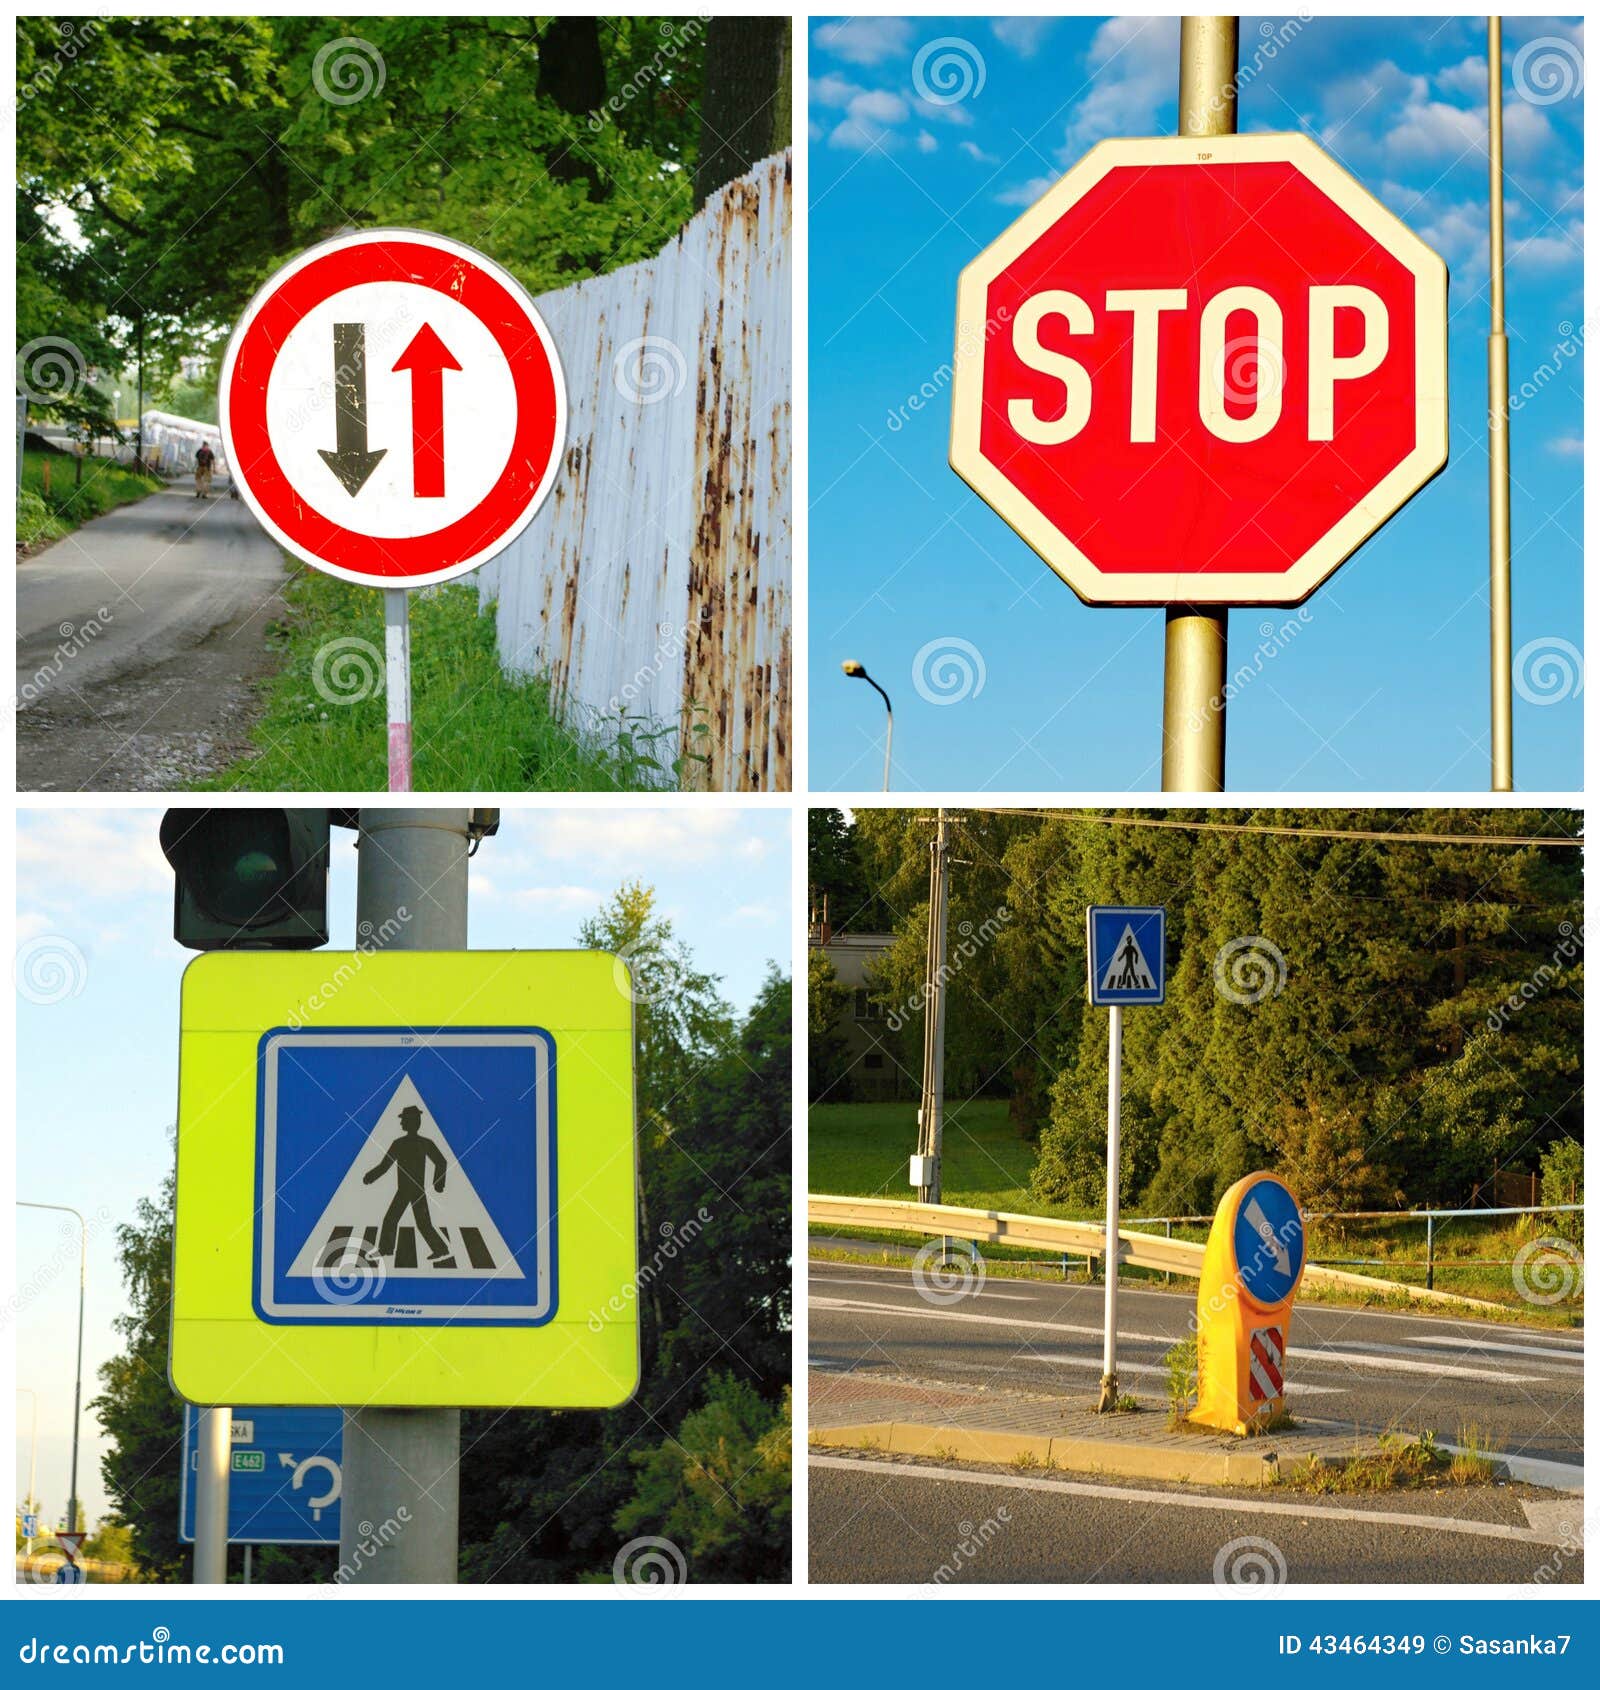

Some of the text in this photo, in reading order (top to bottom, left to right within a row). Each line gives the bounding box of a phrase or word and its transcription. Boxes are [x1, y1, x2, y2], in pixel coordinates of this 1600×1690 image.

[1197, 152, 1213, 161] TOP
[1007, 284, 1390, 446] STOP
[400, 1036, 415, 1045] TOP
[235, 1455, 261, 1468] E462
